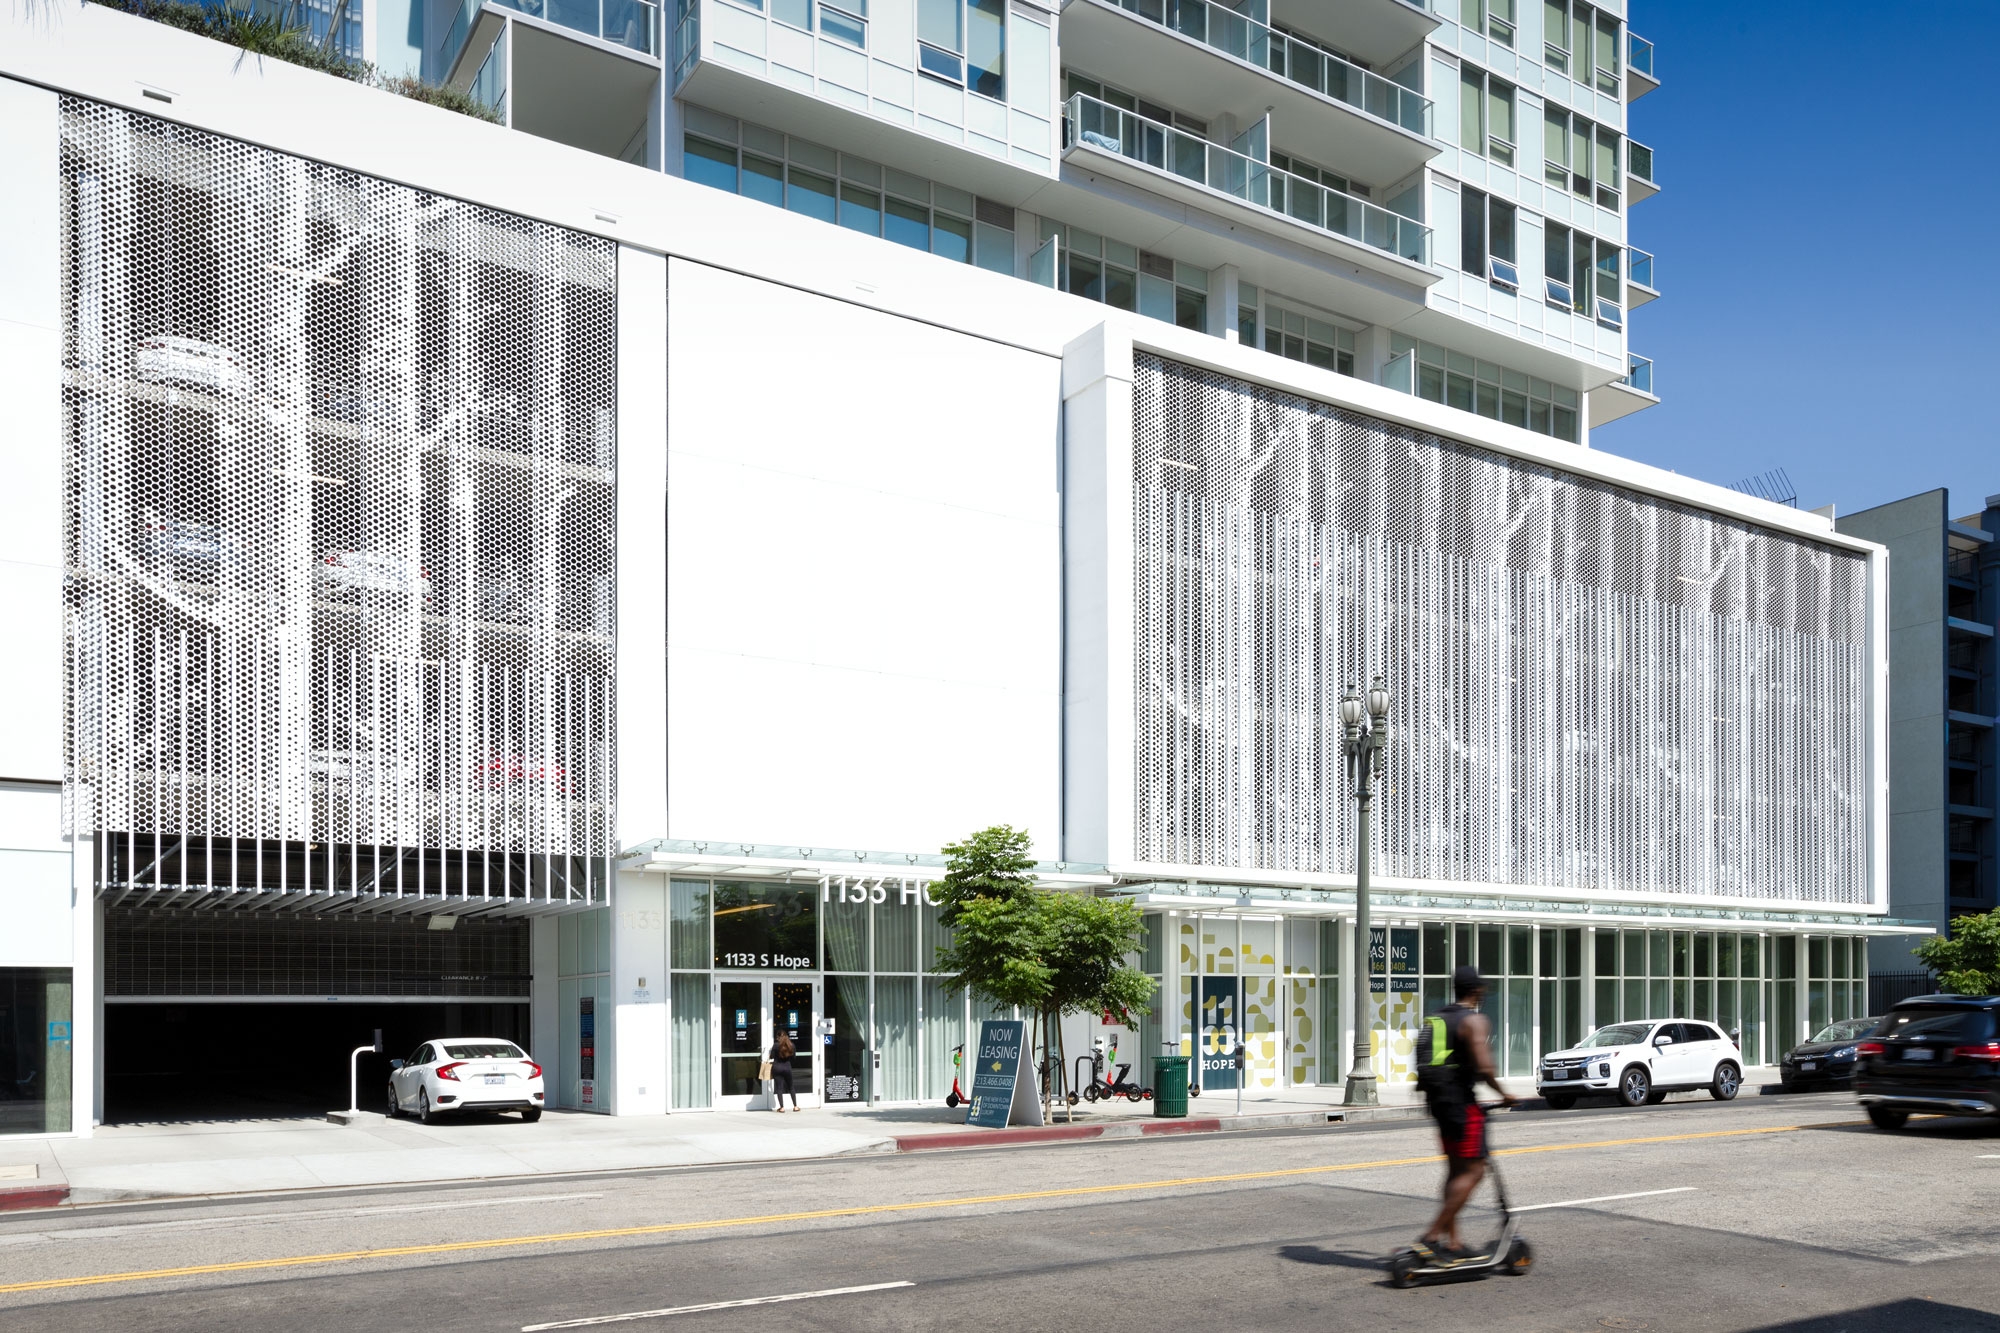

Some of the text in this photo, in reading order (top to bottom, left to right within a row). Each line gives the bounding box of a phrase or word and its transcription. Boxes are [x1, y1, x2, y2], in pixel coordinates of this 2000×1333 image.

[818, 875, 887, 904] 1133
[900, 879, 945, 907] HO
[725, 953, 811, 970] 1133 S Hope
[1203, 995, 1233, 1025] 11
[989, 1028, 1013, 1042] NOW
[1203, 1025, 1236, 1056] 33
[980, 1046, 1018, 1059] LEASING
[1203, 1059, 1236, 1070] HOPE
